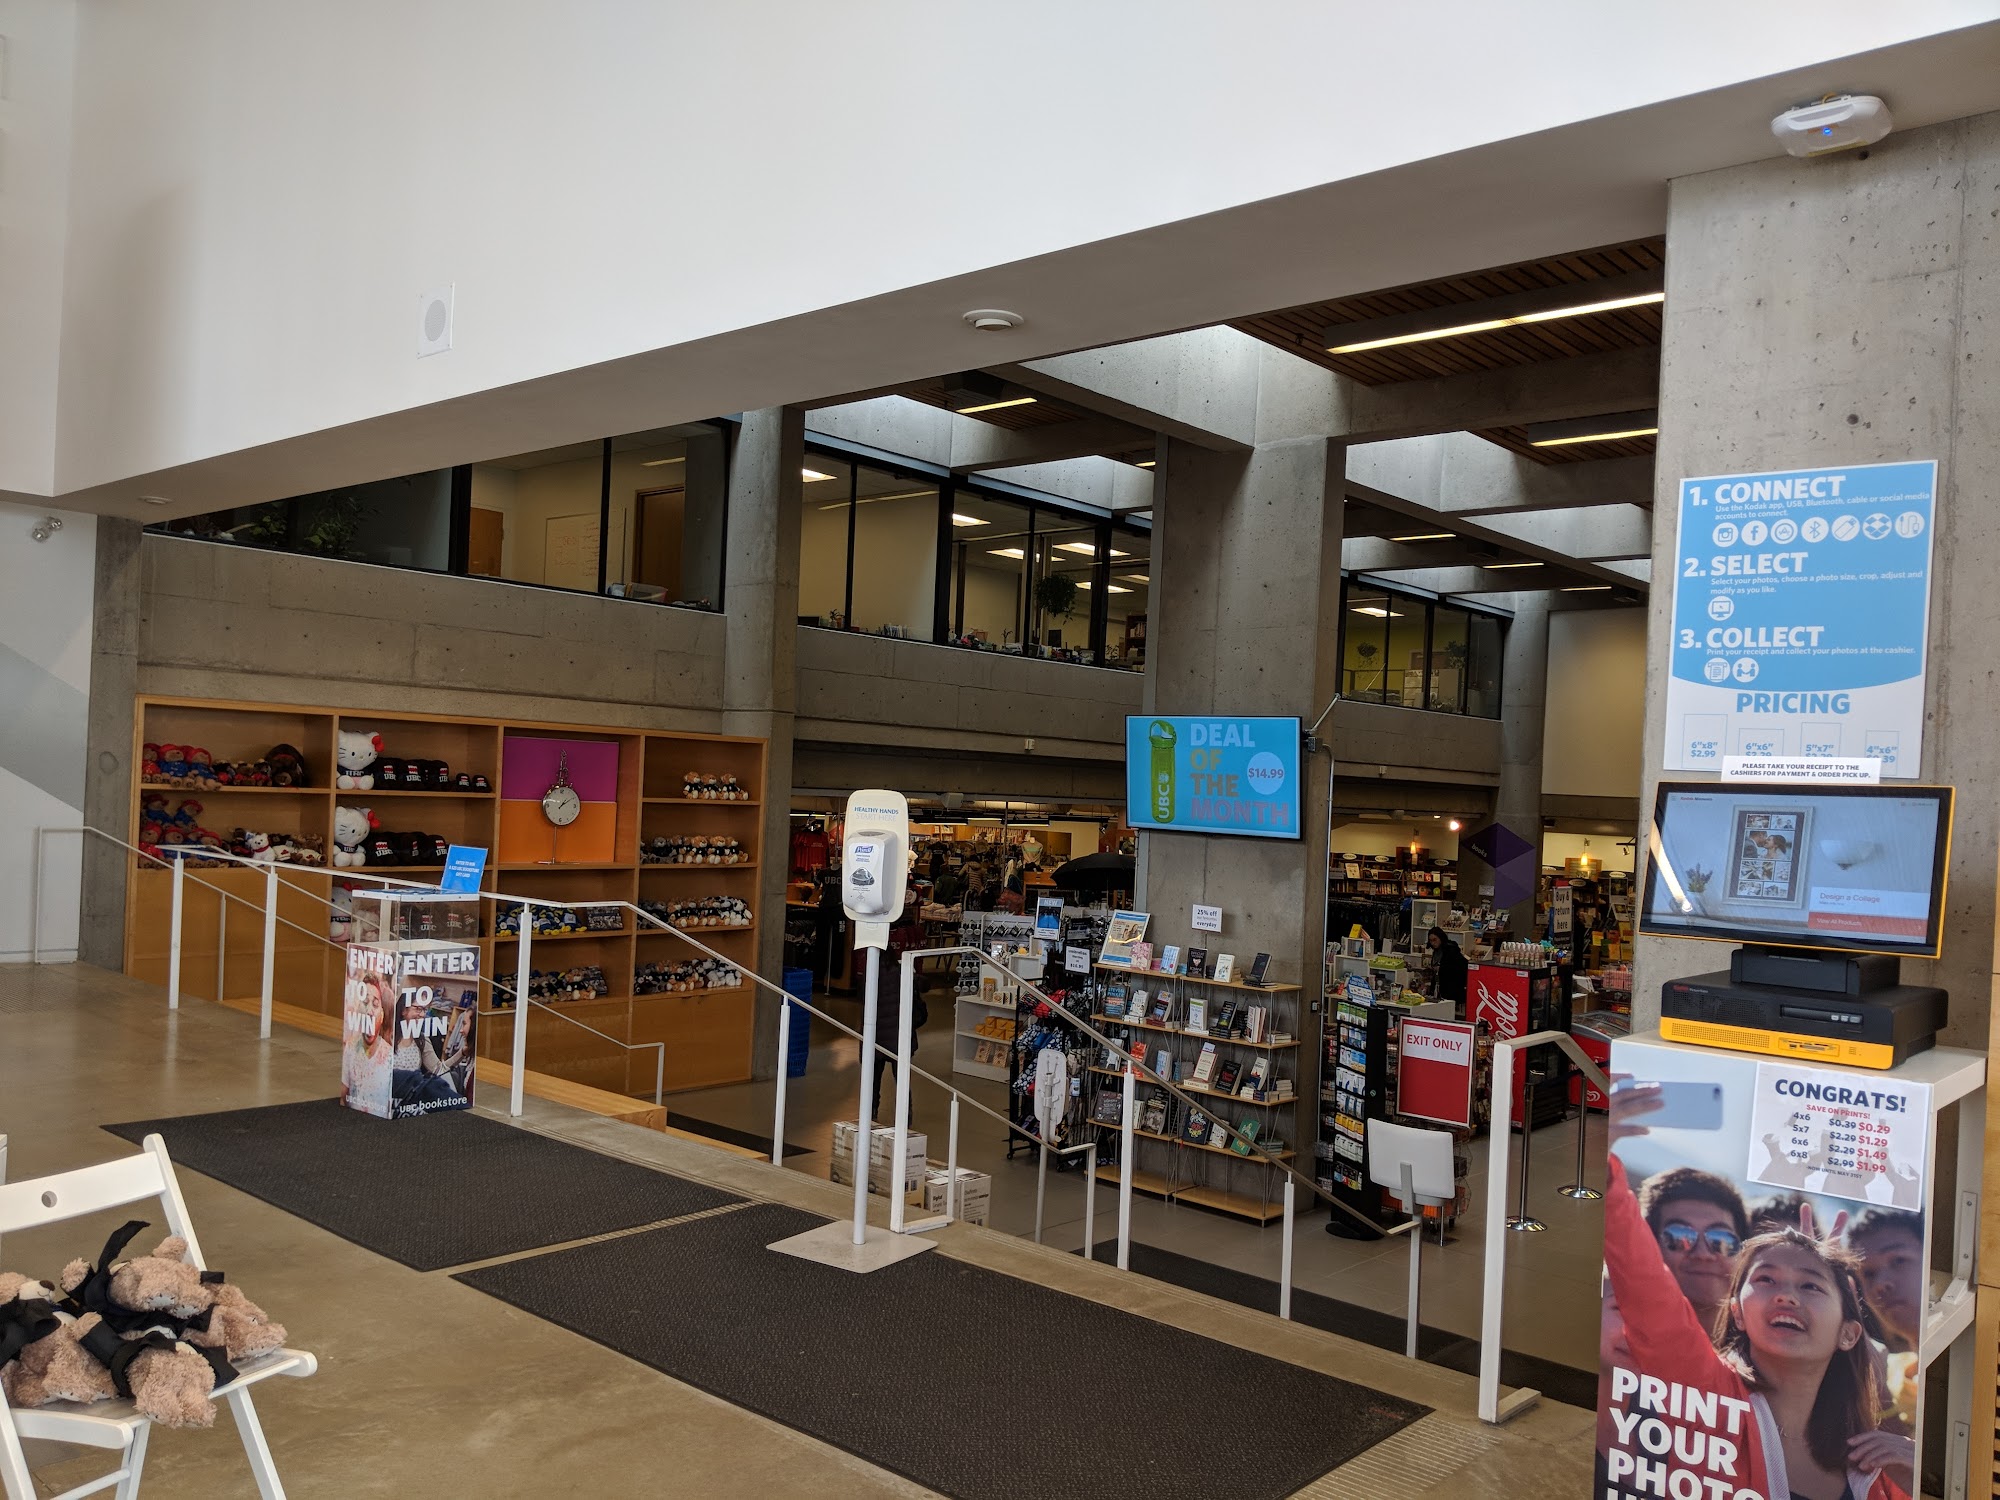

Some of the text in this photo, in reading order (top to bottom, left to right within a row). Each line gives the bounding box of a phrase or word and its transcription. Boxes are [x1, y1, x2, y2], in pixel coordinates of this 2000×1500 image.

[1690, 475, 1846, 506] 1. CONNECT
[1731, 504, 1743, 512] the
[1847, 496, 1868, 504] cable
[1880, 494, 1903, 502] social
[1904, 492, 1930, 500] media
[1715, 512, 1747, 520] accounts
[1684, 552, 1808, 578] 2. SELECT
[1734, 578, 1751, 586] your
[1752, 577, 1780, 585] photos,
[1816, 574, 1838, 582] photo
[1881, 571, 1906, 580] adjust
[1907, 570, 1923, 578] and
[1710, 587, 1735, 595] modify
[1680, 626, 1824, 648] 3. COLLECT
[1812, 648, 1830, 656] your
[1832, 647, 1858, 656] photos
[1736, 693, 1850, 714] PRICING
[1190, 723, 1256, 748] DEAL
[1190, 748, 1224, 771] OF
[1690, 750, 1716, 758] $2.99
[1248, 768, 1284, 779] $14.99
[1190, 773, 1240, 797] THE
[1158, 784, 1170, 819] UBC
[1191, 798, 1289, 826] MONTH
[878, 814, 896, 822] HERE
[1471, 843, 1487, 858] books
[1556, 891, 1566, 904] Buy
[1820, 893, 1844, 901] Design
[1853, 894, 1881, 903] Collage
[1555, 906, 1570, 915] return
[1557, 920, 1568, 930] here
[350, 948, 394, 975] ENTER
[403, 952, 475, 975] ENTER
[348, 980, 368, 1001] TO
[402, 986, 433, 1007] TO
[348, 1010, 375, 1036] WIN
[400, 1016, 448, 1039] WIN
[1406, 1033, 1463, 1052] EXIT ONLY
[400, 1104, 417, 1113] UBC
[419, 1096, 467, 1110] bookstore
[1775, 1078, 1907, 1113] CONGRATS!
[1806, 1104, 1827, 1113] SAVE
[1840, 1109, 1870, 1119] PRINTS!
[1794, 1112, 1890, 1134] 4x6 $0.39 $0.29
[1792, 1124, 1888, 1147] 5x7 $2.29 $1.29
[1791, 1137, 1887, 1160] 6x6 $2.29 $1.49
[1790, 1150, 1886, 1173] 6x8 $2.99 $1.99
[1611, 1366, 1750, 1435] PRINT
[1608, 1407, 1738, 1477] YOUR
